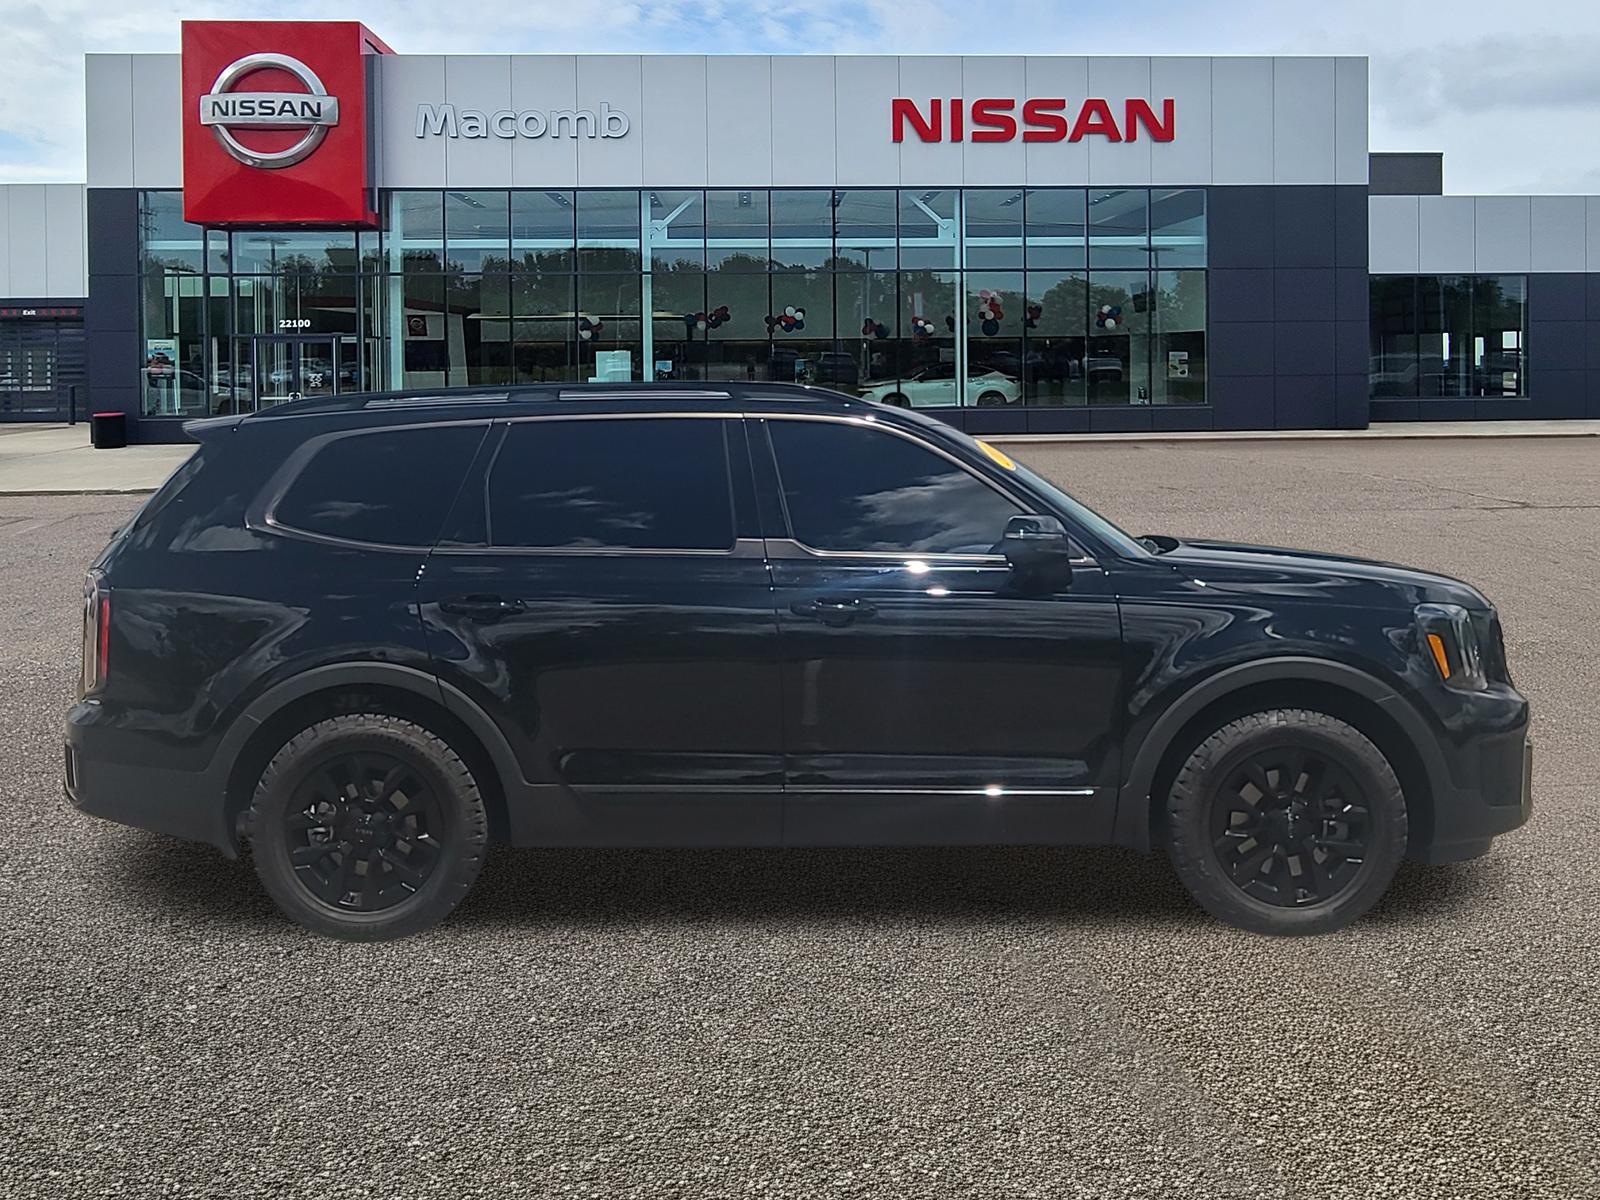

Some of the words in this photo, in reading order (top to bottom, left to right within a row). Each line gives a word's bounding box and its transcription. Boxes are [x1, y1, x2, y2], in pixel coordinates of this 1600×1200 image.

[211, 100, 322, 117] NISSAN
[415, 101, 630, 139] Macomb
[892, 98, 1175, 143] NISSAN
[279, 319, 311, 328] 22100
